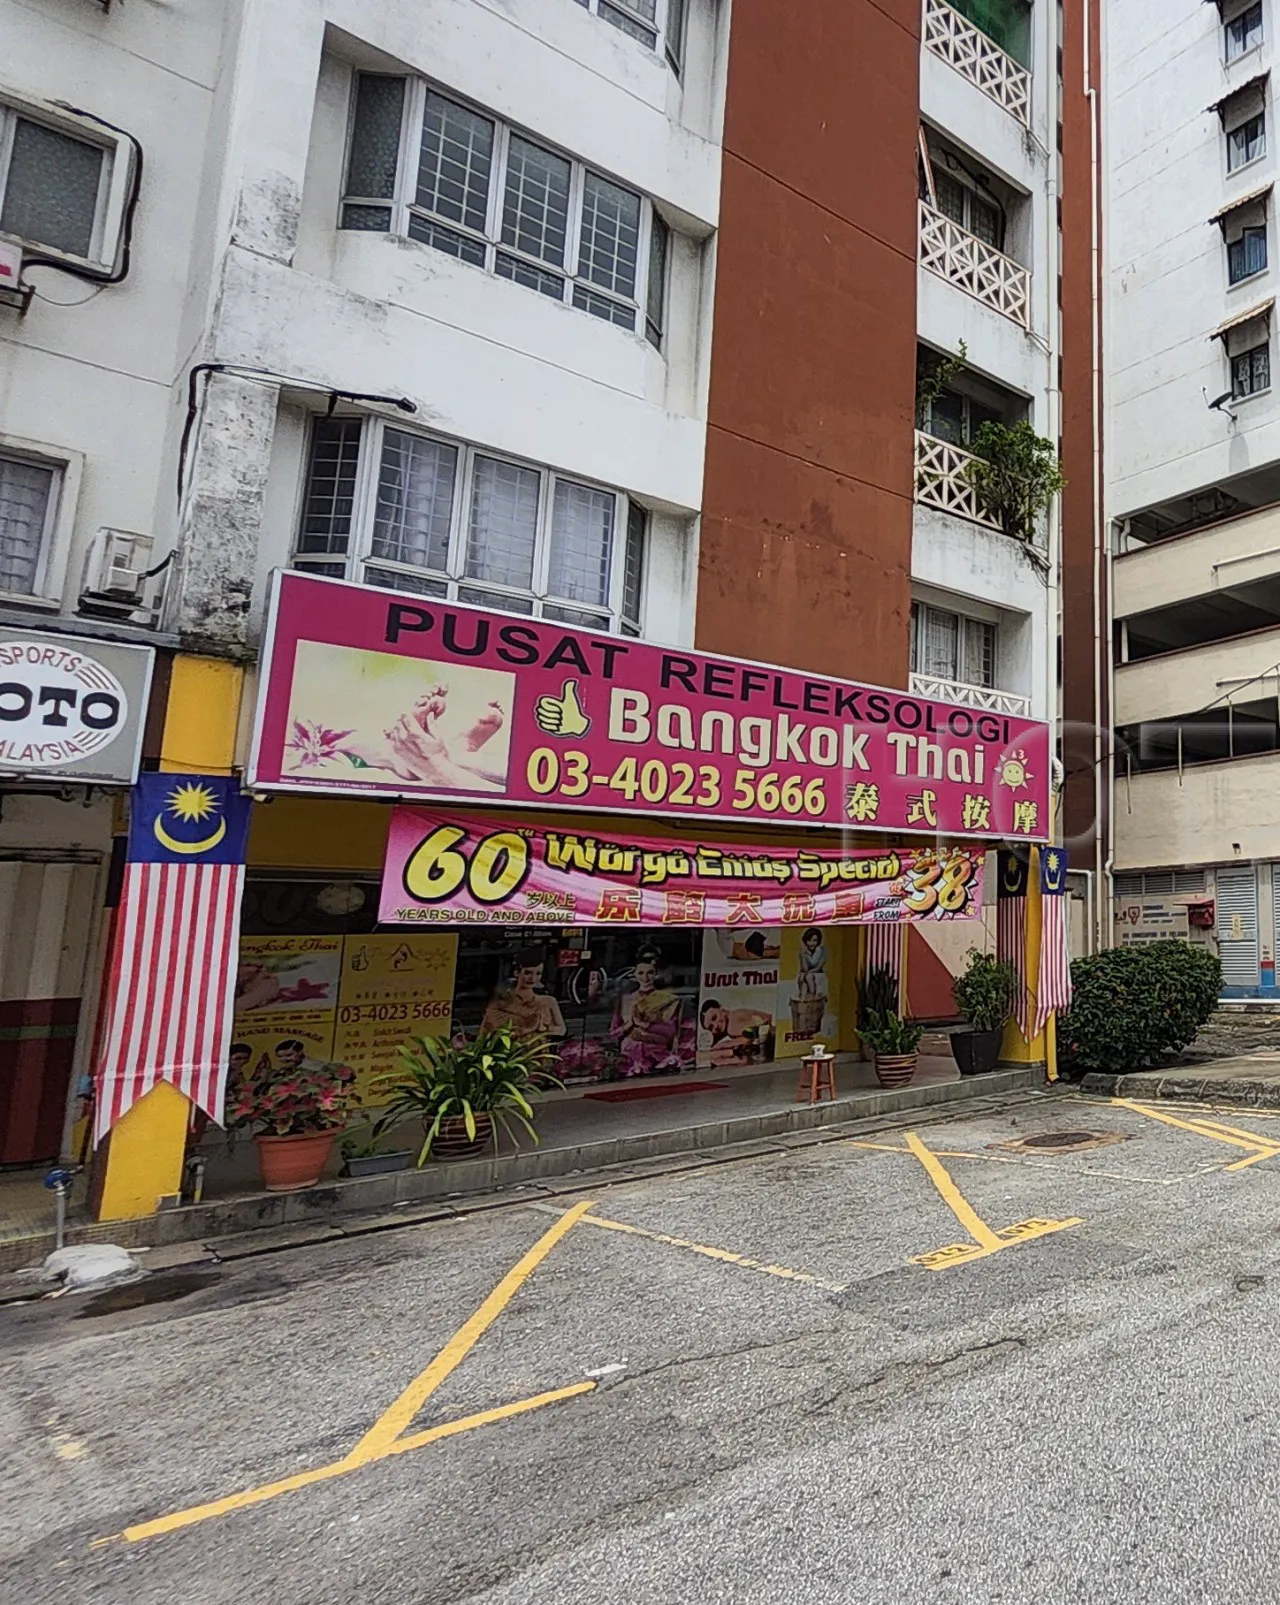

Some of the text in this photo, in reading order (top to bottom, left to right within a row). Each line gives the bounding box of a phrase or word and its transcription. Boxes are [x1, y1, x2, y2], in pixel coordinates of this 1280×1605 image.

[0, 646, 82, 673] SPORTS
[384, 602, 1011, 745] PUSAT REFLEKSOLOGI
[608, 686, 986, 786] Bangkok Thai
[526, 746, 827, 817] 03-4023 5666
[844, 782, 1039, 834] 泰式按摩
[402, 823, 530, 904] 60
[904, 854, 976, 914] 38
[396, 908, 576, 923] YEARS OLD AND ABOVE
[704, 970, 778, 988] Urut Thai
[340, 1005, 408, 1024] 03-4023
[412, 1003, 450, 1020] 5666
